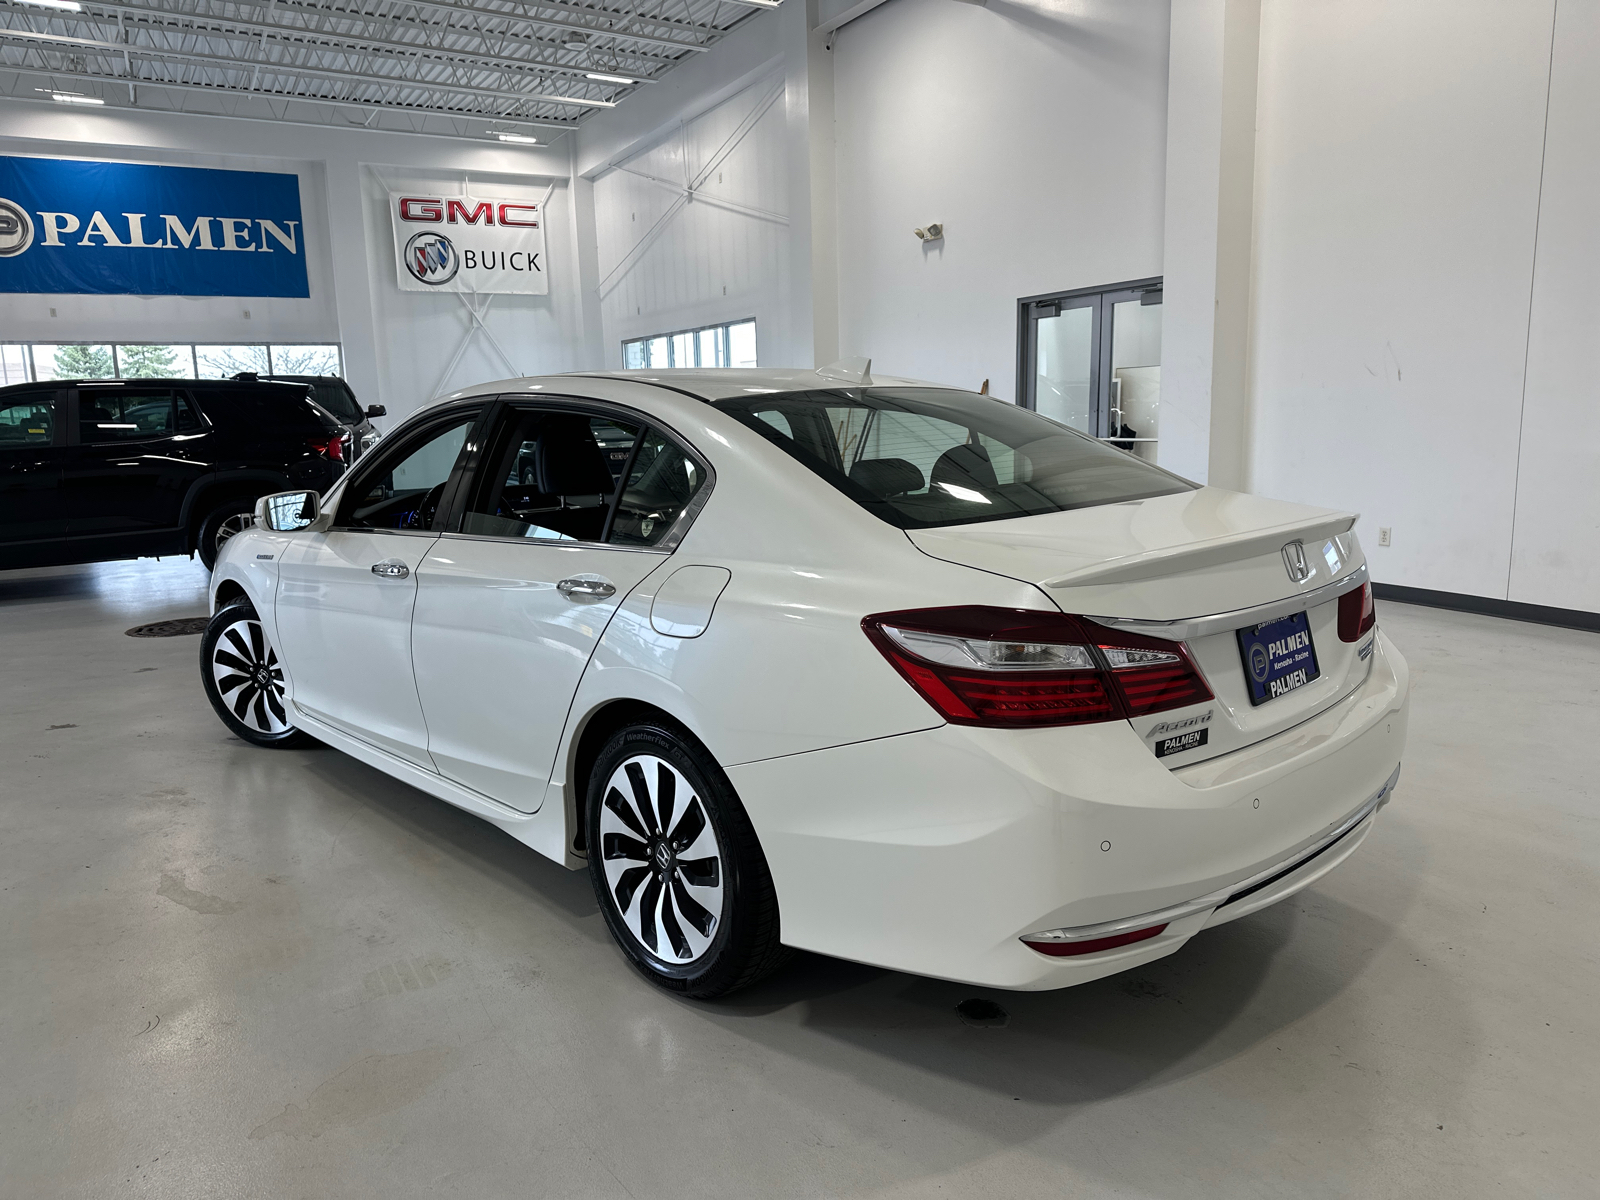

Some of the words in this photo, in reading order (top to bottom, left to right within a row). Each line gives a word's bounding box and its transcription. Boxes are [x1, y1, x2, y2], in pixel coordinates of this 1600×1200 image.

[399, 196, 539, 229] GMC
[36, 210, 299, 255] PALMEN
[464, 250, 541, 271] BUICK
[1268, 630, 1310, 660] PALMEN
[1274, 657, 1293, 670] Kenosha
[1295, 651, 1309, 663] Racine
[1270, 668, 1307, 698] PALMEN
[1145, 709, 1214, 739] Accord
[626, 732, 670, 749] Weatherflex
[1164, 731, 1201, 750] PALMEN
